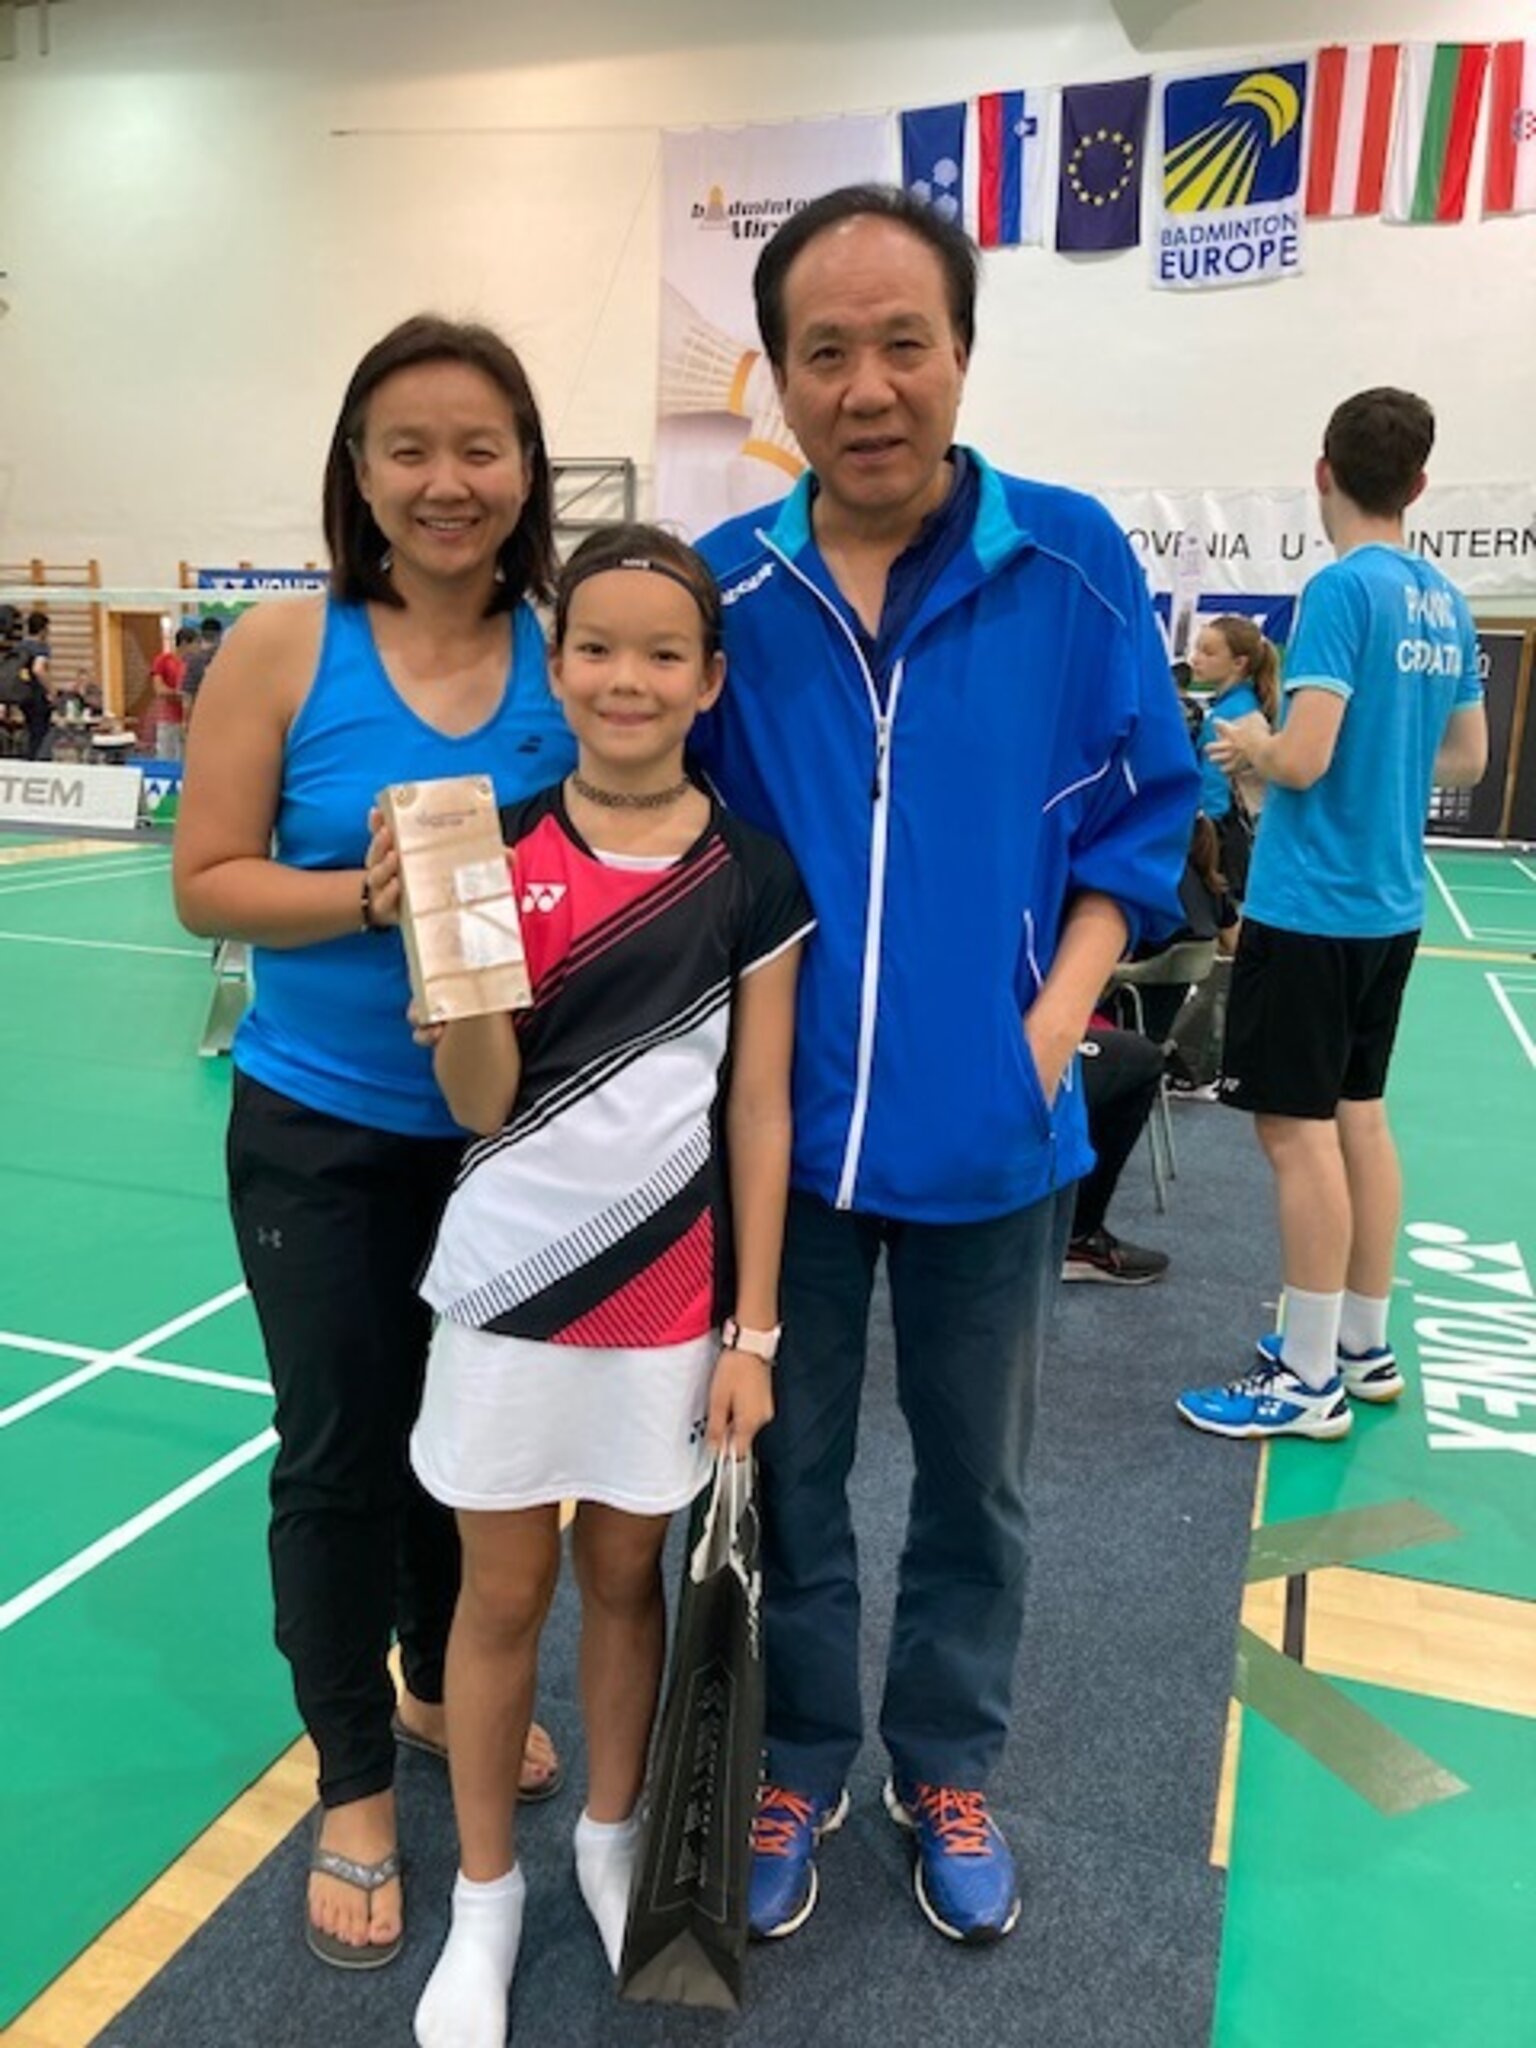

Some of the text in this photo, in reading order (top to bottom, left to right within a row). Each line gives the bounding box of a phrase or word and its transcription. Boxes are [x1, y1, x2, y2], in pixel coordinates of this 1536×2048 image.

[1161, 211, 1297, 246] BADMINTON
[1161, 236, 1297, 279] EUROPE
[1413, 1293, 1536, 1457] YONEX
